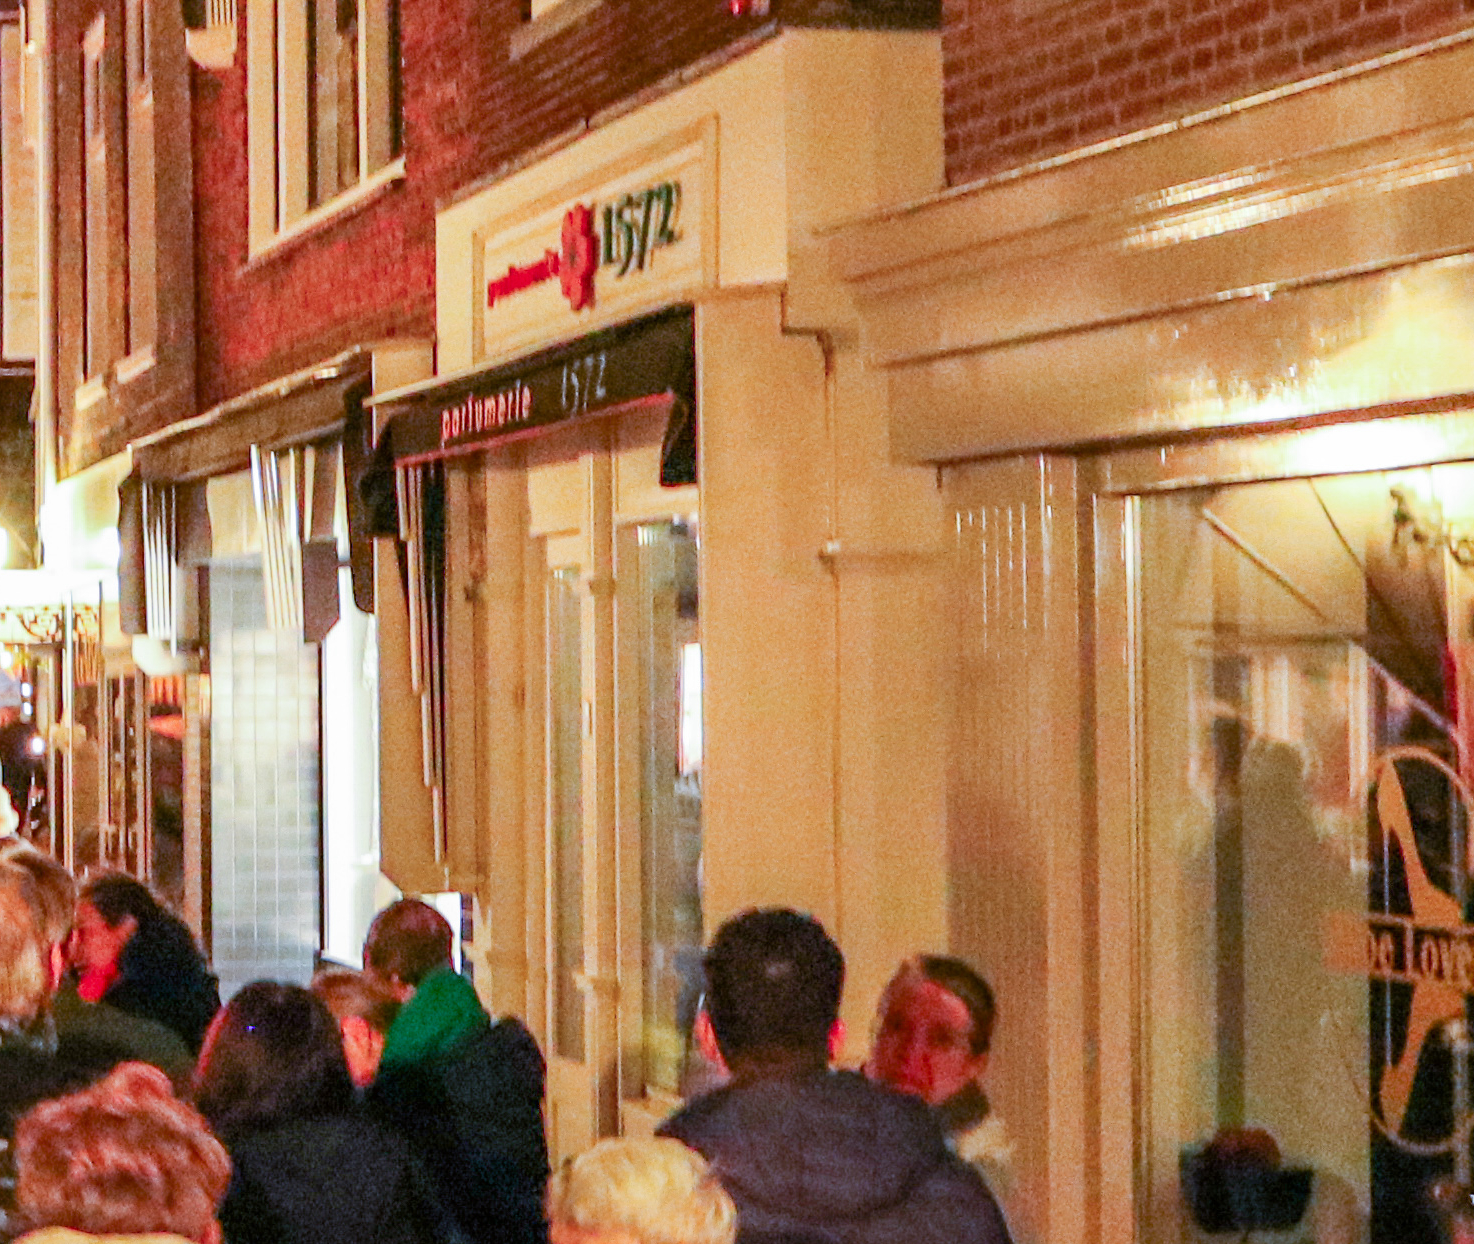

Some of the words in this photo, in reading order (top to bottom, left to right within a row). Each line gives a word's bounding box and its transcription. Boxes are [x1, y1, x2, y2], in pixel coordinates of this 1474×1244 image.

[603, 182, 681, 278] 1572
[440, 379, 532, 451] parfumerie
[560, 350, 608, 418] 1572
